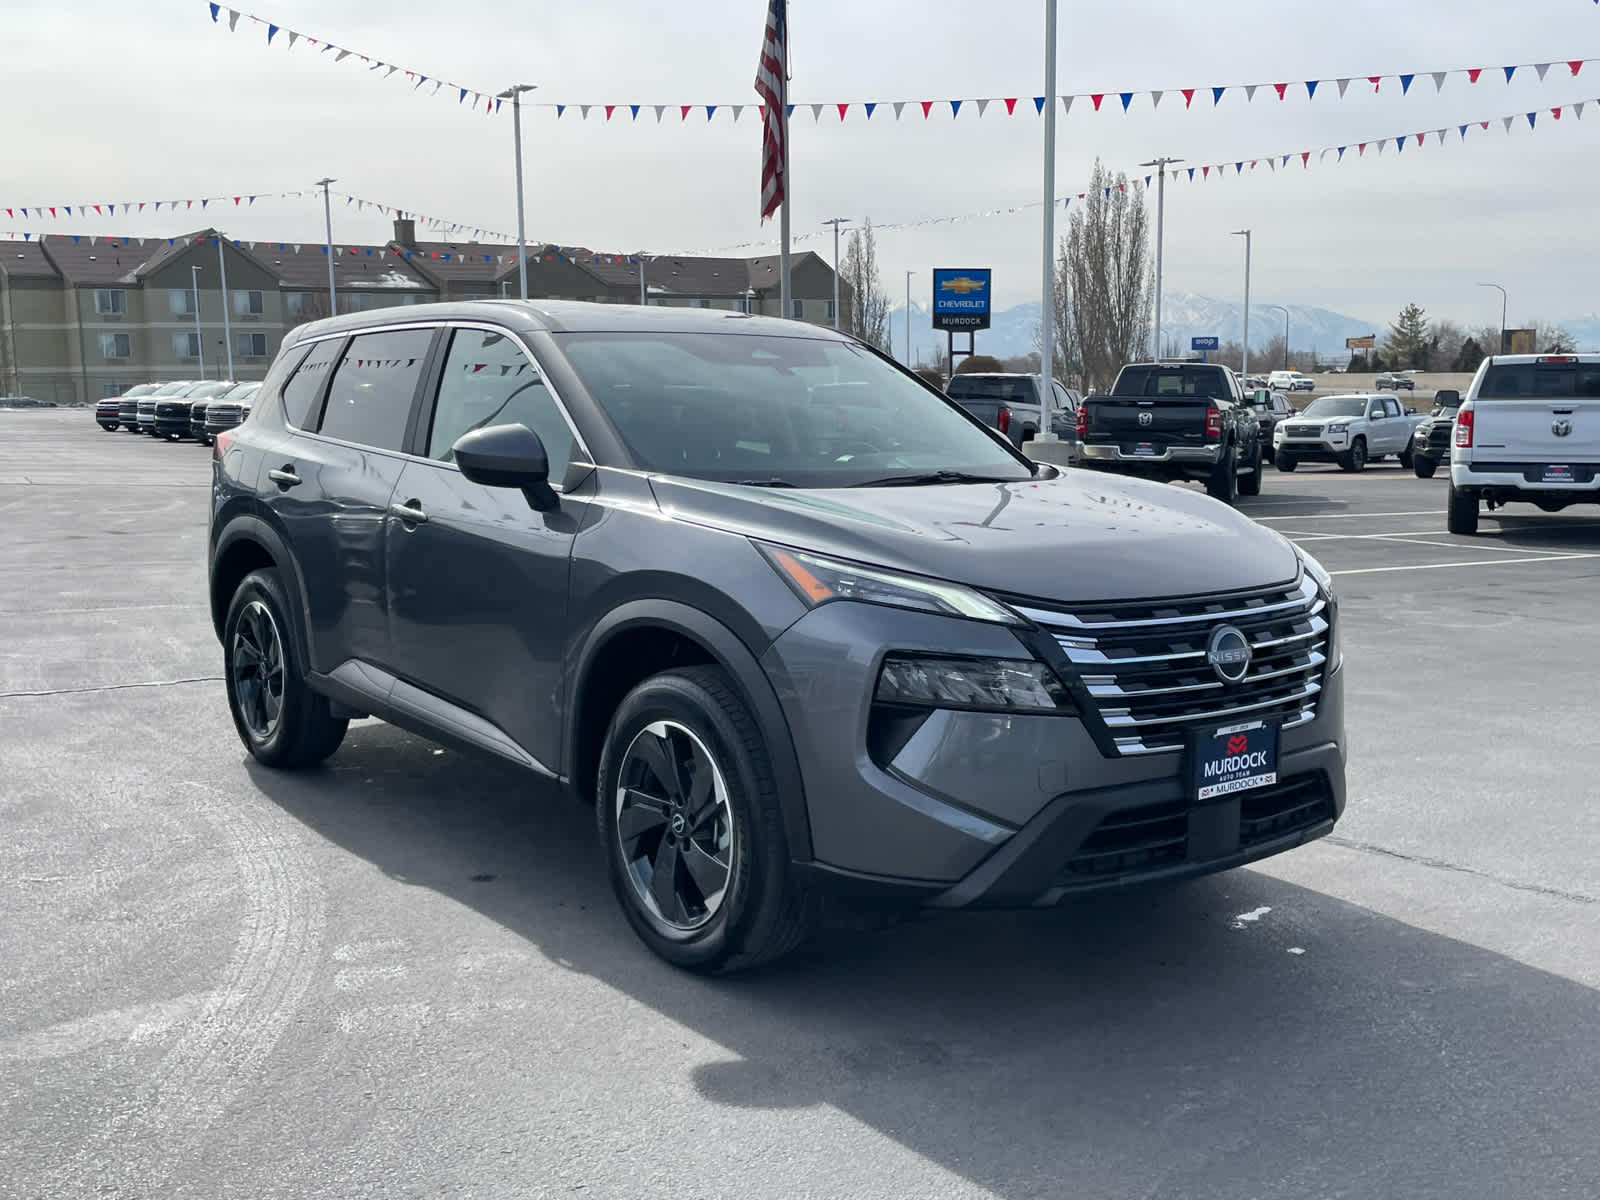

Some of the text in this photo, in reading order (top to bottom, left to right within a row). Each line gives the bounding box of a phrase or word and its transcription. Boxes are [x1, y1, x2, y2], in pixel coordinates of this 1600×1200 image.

[938, 300, 985, 308] CHEVROLET
[942, 317, 982, 325] MURDOCK
[1204, 750, 1267, 778] MURDOCK
[1219, 770, 1251, 782] AUTO TEAM
[1216, 777, 1259, 793] MURDOCK
